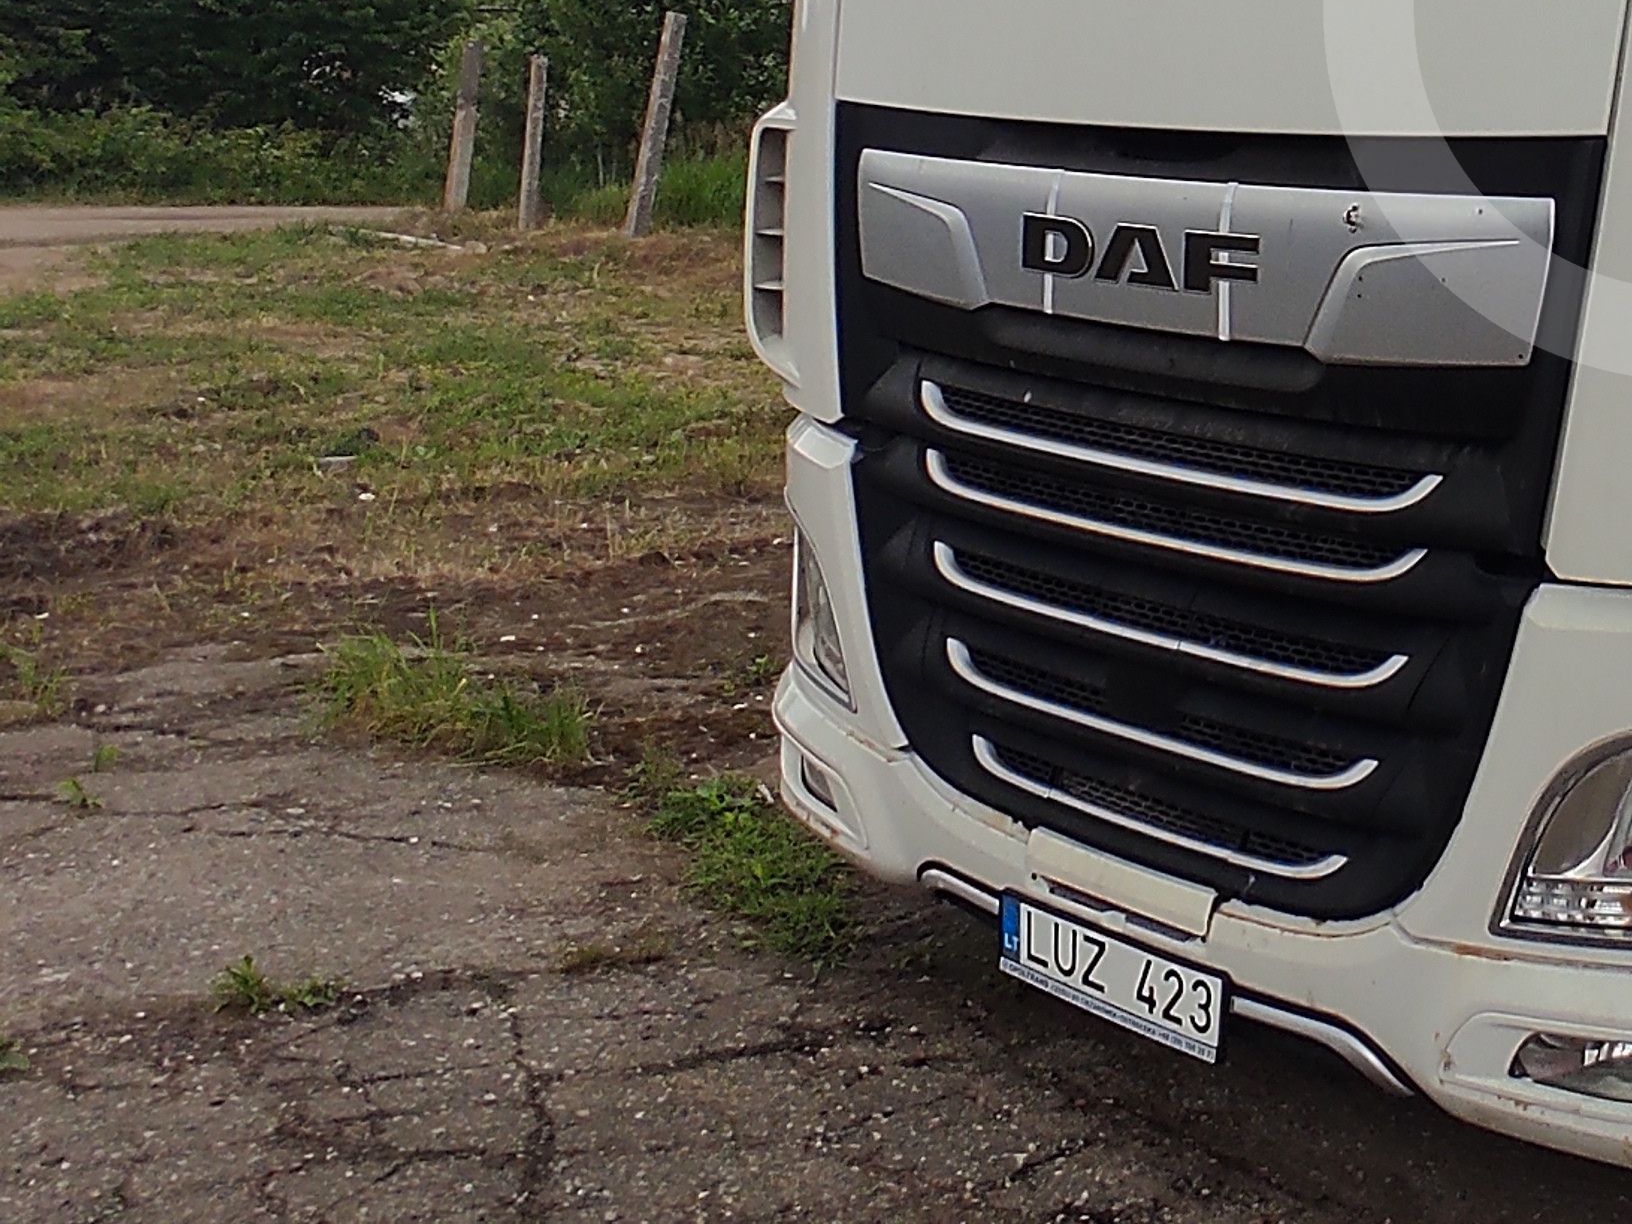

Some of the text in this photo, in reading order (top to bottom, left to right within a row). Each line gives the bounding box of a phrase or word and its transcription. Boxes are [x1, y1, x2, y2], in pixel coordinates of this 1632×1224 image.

[1020, 210, 1260, 294] DAF
[1004, 933, 1018, 951] LT
[1026, 910, 1106, 994] LUZ
[1136, 959, 1212, 1034] 423
